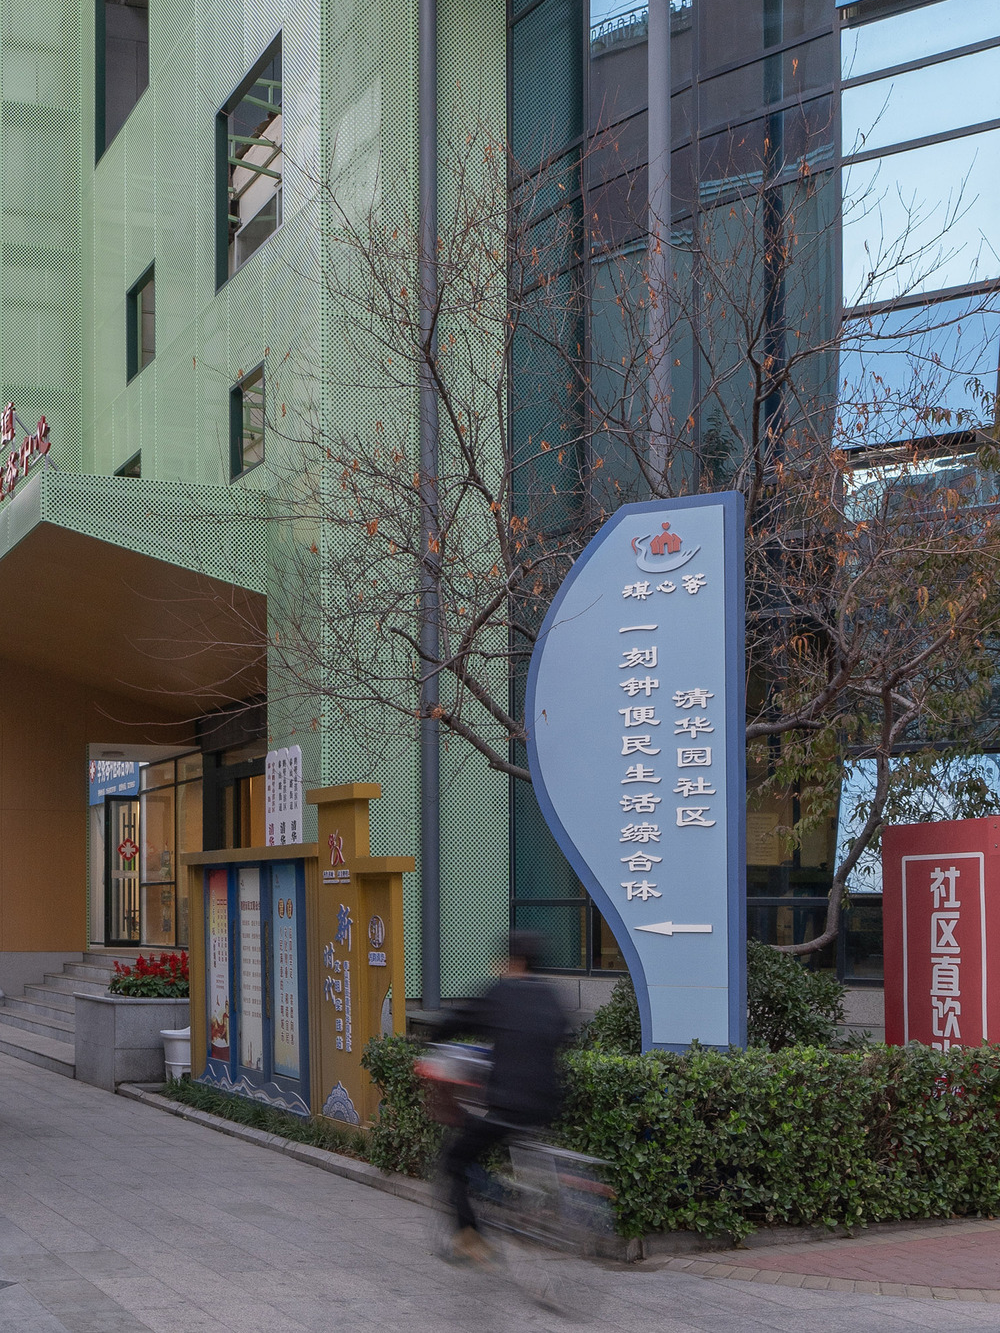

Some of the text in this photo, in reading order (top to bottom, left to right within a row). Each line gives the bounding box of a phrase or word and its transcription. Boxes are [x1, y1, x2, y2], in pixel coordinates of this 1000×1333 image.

[618, 623, 662, 901] 一刻钟便民生活综合体
[671, 687, 716, 828] 清华园社区
[930, 866, 961, 1053] 社区直饮
